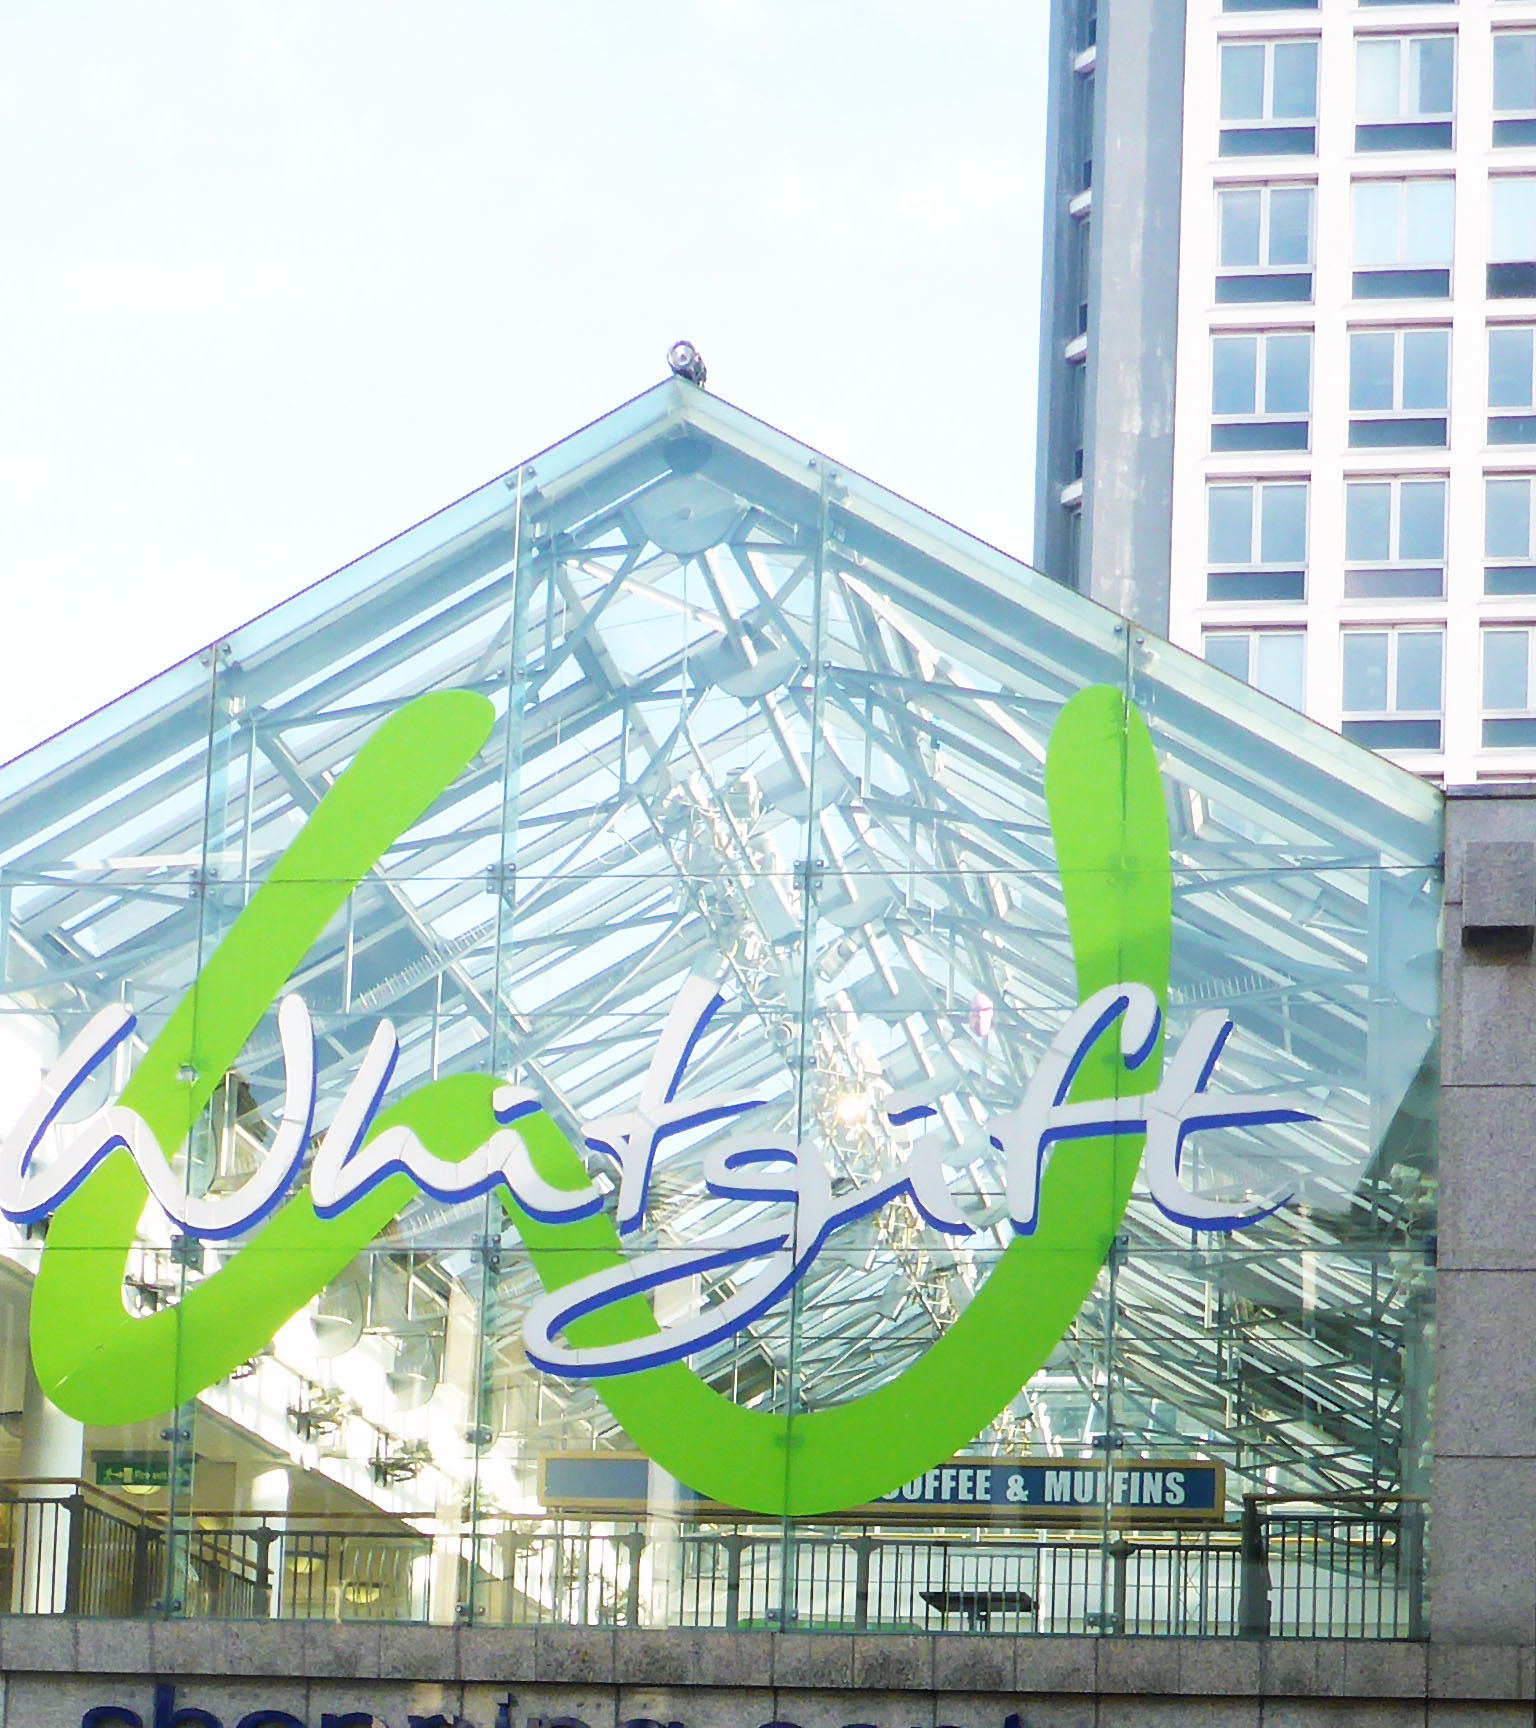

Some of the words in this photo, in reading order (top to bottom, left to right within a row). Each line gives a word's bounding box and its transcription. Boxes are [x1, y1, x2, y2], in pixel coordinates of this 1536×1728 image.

[0, 982, 1322, 1379] Whitgift
[881, 1468, 992, 1502] OFFEE
[1006, 1474, 1029, 1502] &
